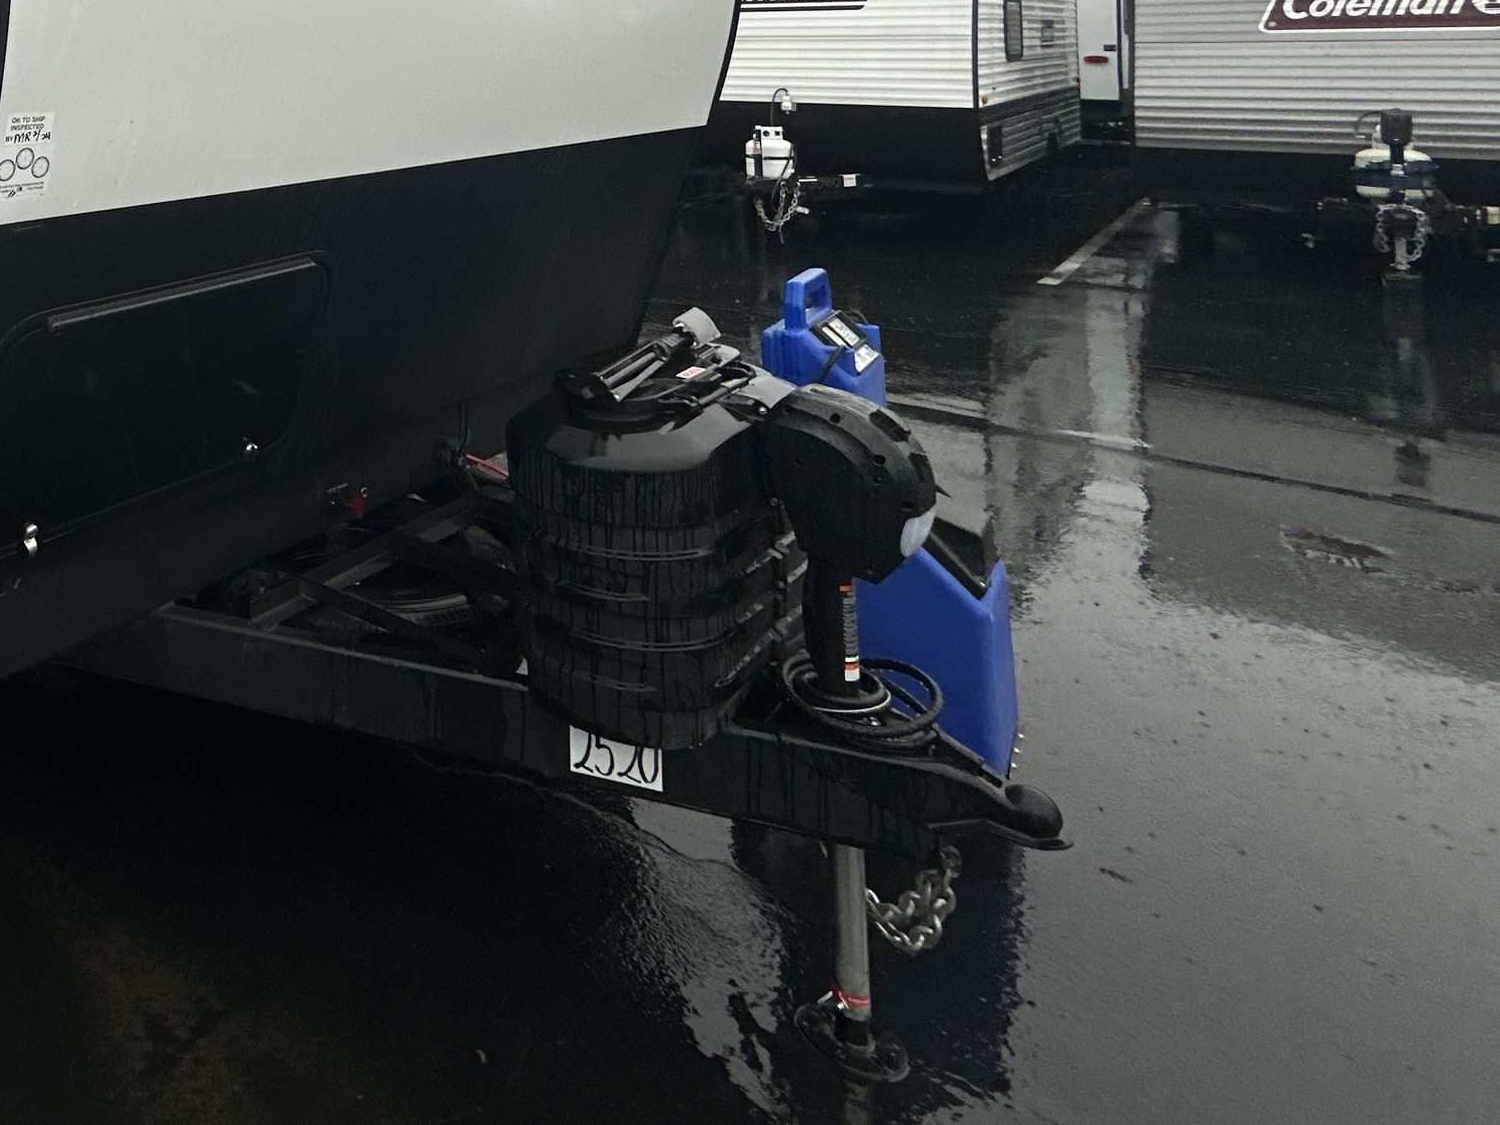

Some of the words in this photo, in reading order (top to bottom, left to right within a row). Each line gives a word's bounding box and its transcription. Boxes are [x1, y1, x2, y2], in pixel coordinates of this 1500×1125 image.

[23, 116, 31, 124] TO
[31, 115, 46, 123] SHIP
[10, 123, 45, 131] INSPECTED
